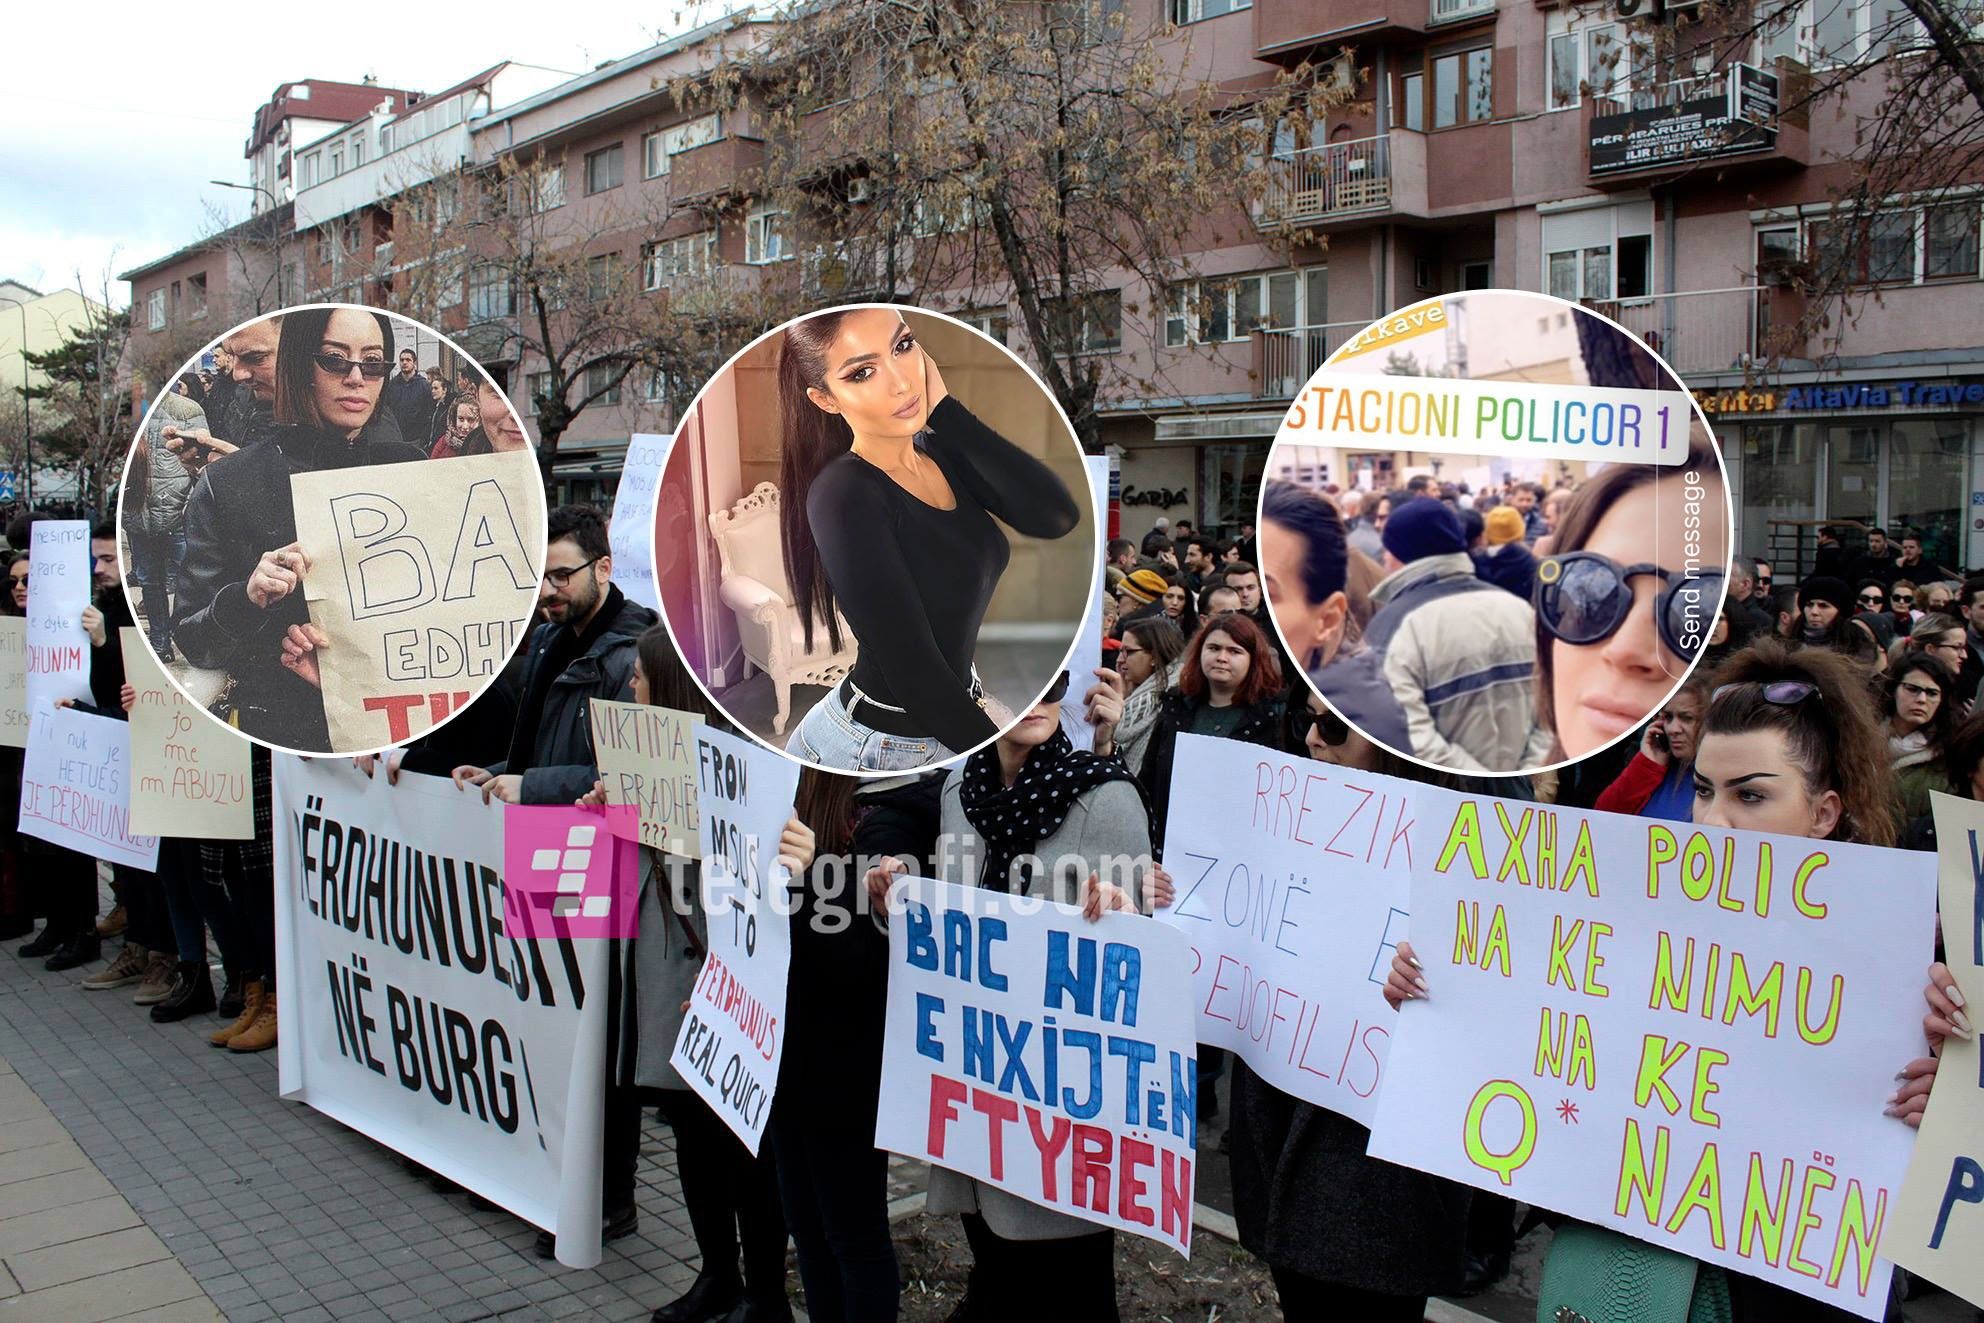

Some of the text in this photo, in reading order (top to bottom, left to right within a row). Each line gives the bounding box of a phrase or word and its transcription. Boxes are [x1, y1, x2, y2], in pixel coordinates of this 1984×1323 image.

[1785, 385, 1890, 410] AltaVia
[164, 743, 199, 763] me
[592, 703, 688, 765] VIKTIMA
[698, 738, 748, 807] FROM
[23, 780, 43, 815] JE
[1253, 762, 1415, 872] RREZIK
[294, 795, 586, 1010] ËRDHUNUESIT
[1175, 852, 1311, 956] ZONË
[1435, 801, 1830, 920] AXHA POLIC
[729, 895, 756, 958] TO
[906, 899, 1141, 1028] BAC NA
[1452, 900, 1844, 1046] NA KE NIMU
[327, 952, 387, 1077] NË
[916, 992, 946, 1063] E
[1534, 1007, 1730, 1130] NA KE
[681, 1014, 768, 1131] REAL QUICK
[927, 1073, 1191, 1248] FTYRËN
[1614, 1118, 1888, 1297] NANËN
